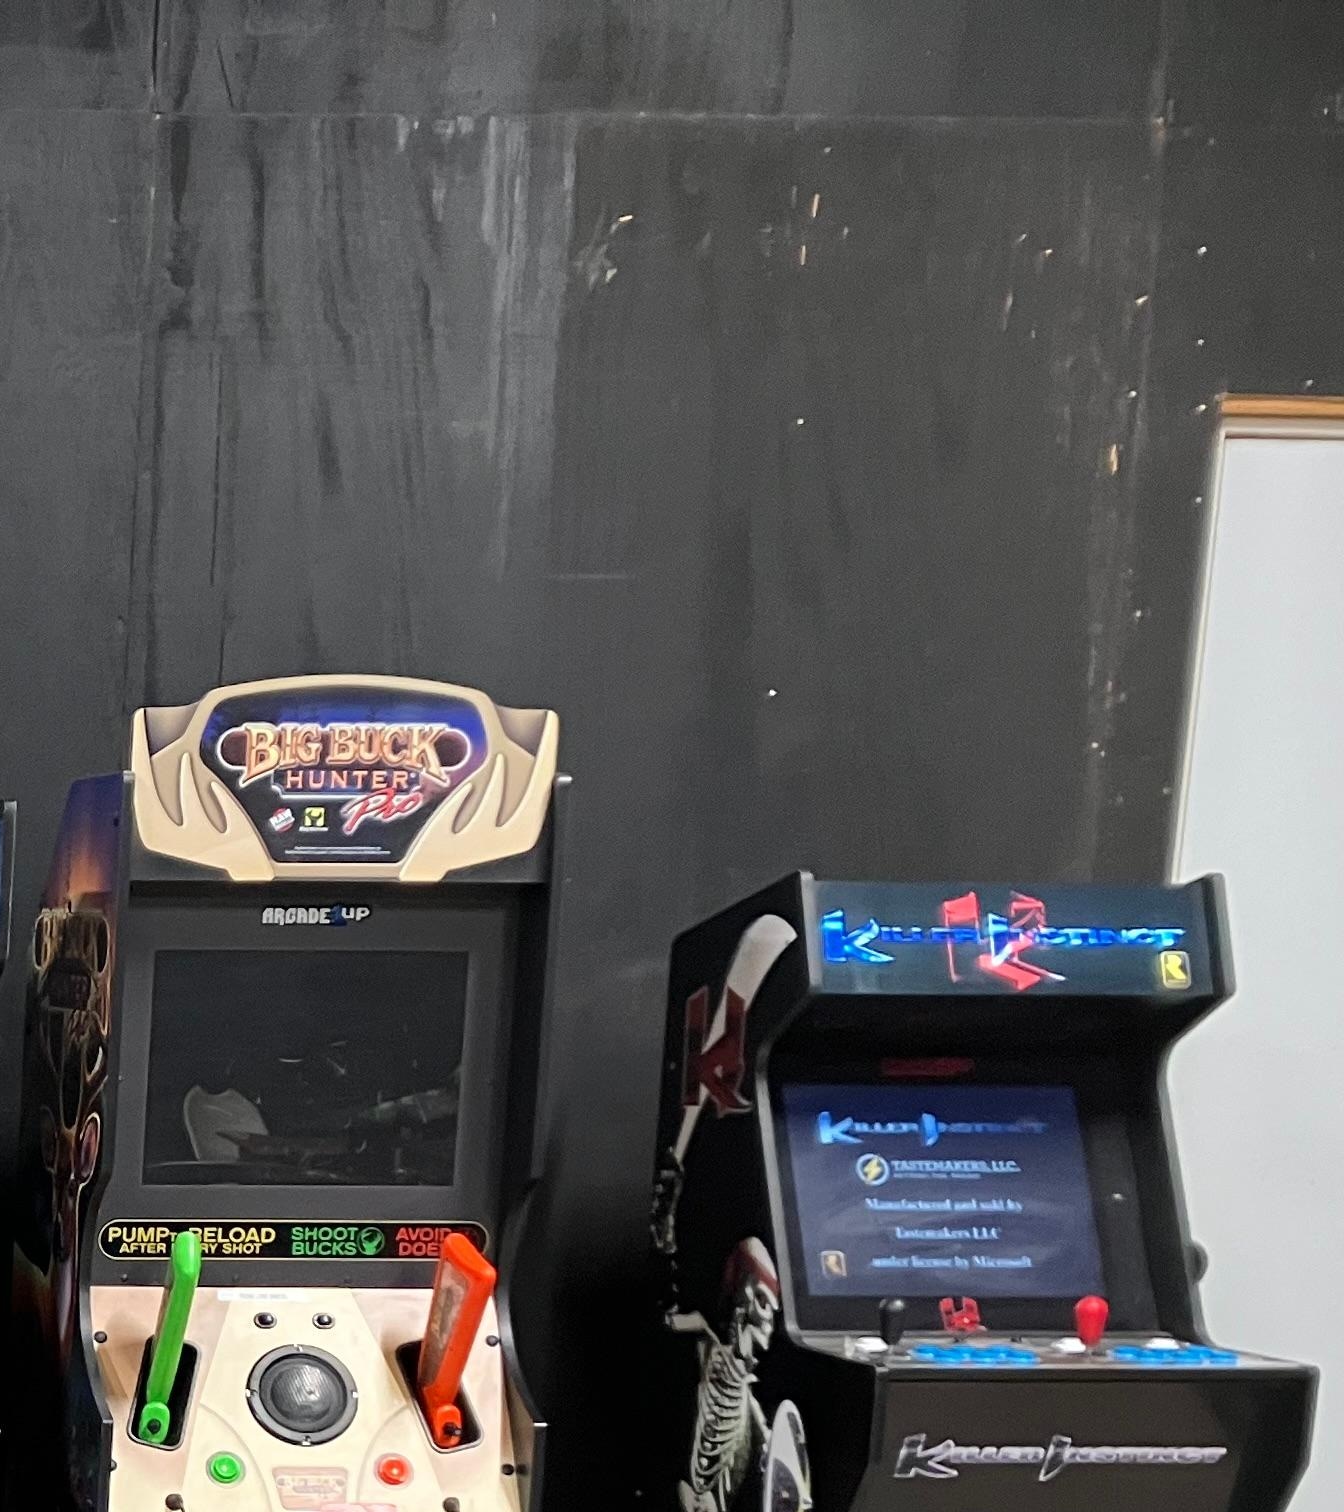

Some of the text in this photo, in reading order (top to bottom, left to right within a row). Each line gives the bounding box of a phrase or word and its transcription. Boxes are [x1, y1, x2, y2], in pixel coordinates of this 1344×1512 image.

[241, 724, 449, 786] BIG BUCK
[285, 769, 409, 790] HUNTER
[822, 908, 982, 964] KILLER
[108, 1226, 170, 1243] PUMP
[291, 1226, 360, 1242] SHOOT
[119, 1242, 167, 1254] AFTER
[221, 1243, 263, 1255] SHOT
[291, 1241, 359, 1256] BUCKS
[398, 1241, 440, 1256] DOE
